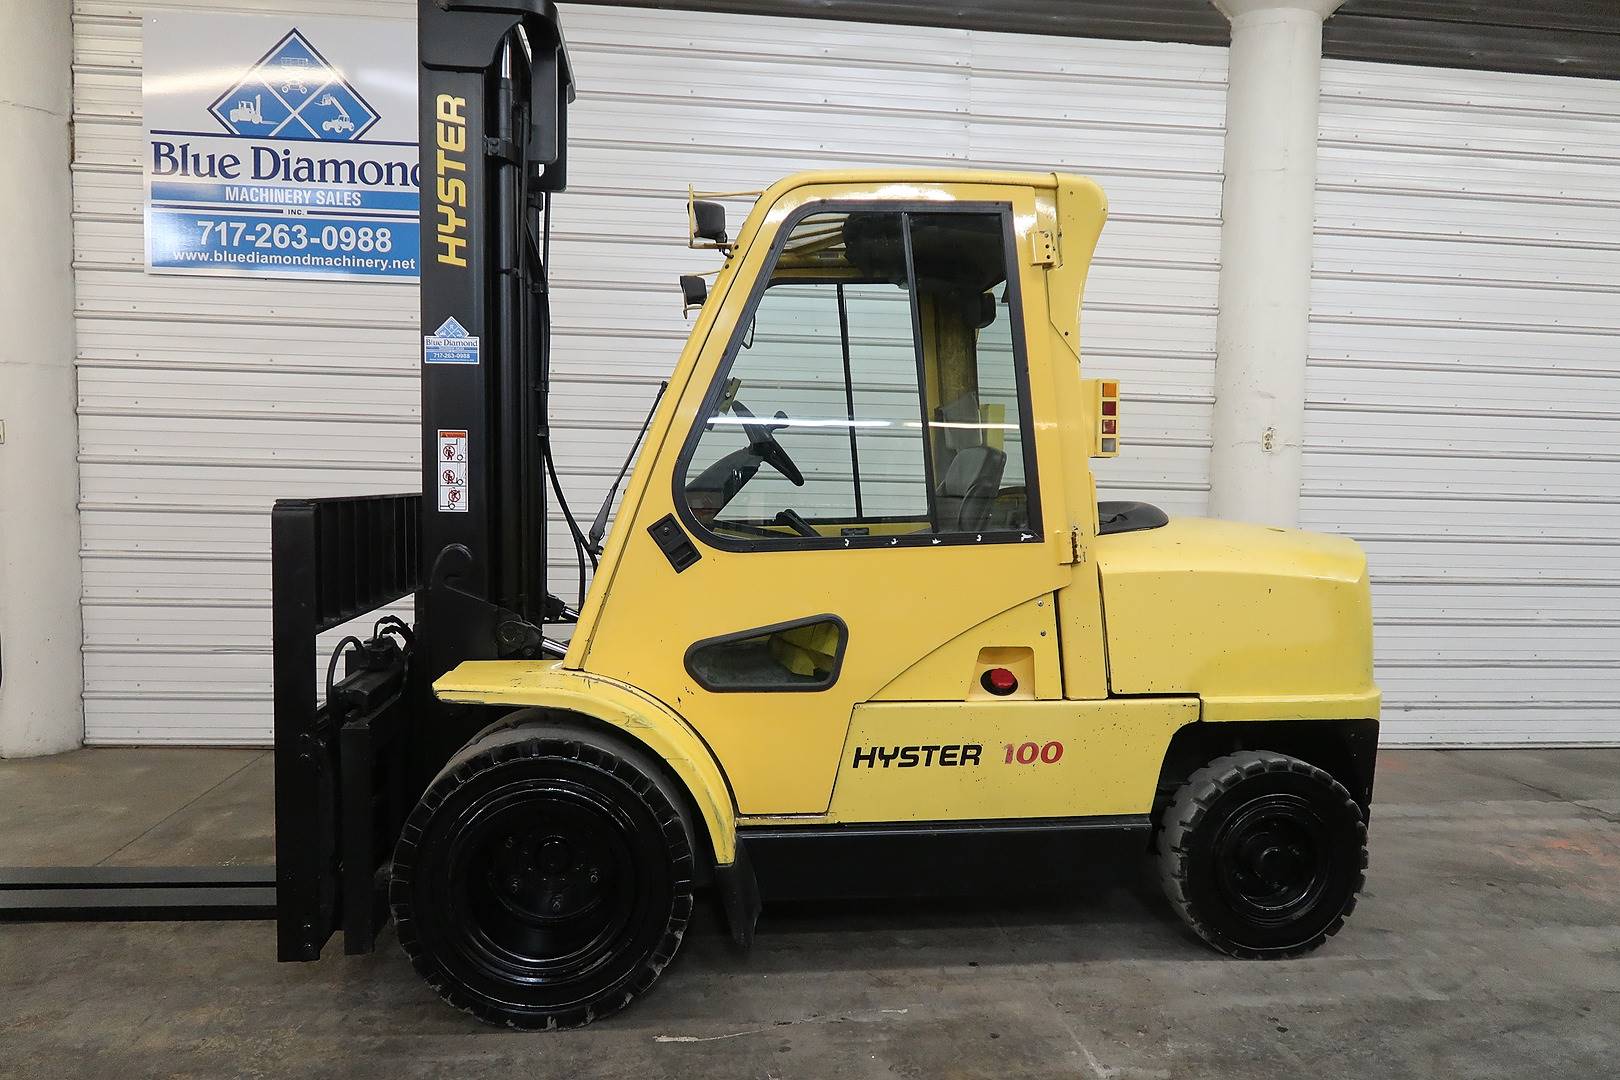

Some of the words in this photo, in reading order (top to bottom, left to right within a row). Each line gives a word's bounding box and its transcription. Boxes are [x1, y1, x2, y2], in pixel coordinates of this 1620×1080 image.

[151, 141, 241, 179] Blue
[436, 94, 467, 267] HYSTER
[225, 186, 312, 205] MACHINERY
[316, 190, 362, 206] SALES
[287, 208, 305, 216] INC.
[197, 221, 392, 252] 717-263-0988
[173, 250, 416, 269] www.bluediamondmachinery.net
[852, 744, 983, 768] HYSTER
[1003, 741, 1064, 765] 100
